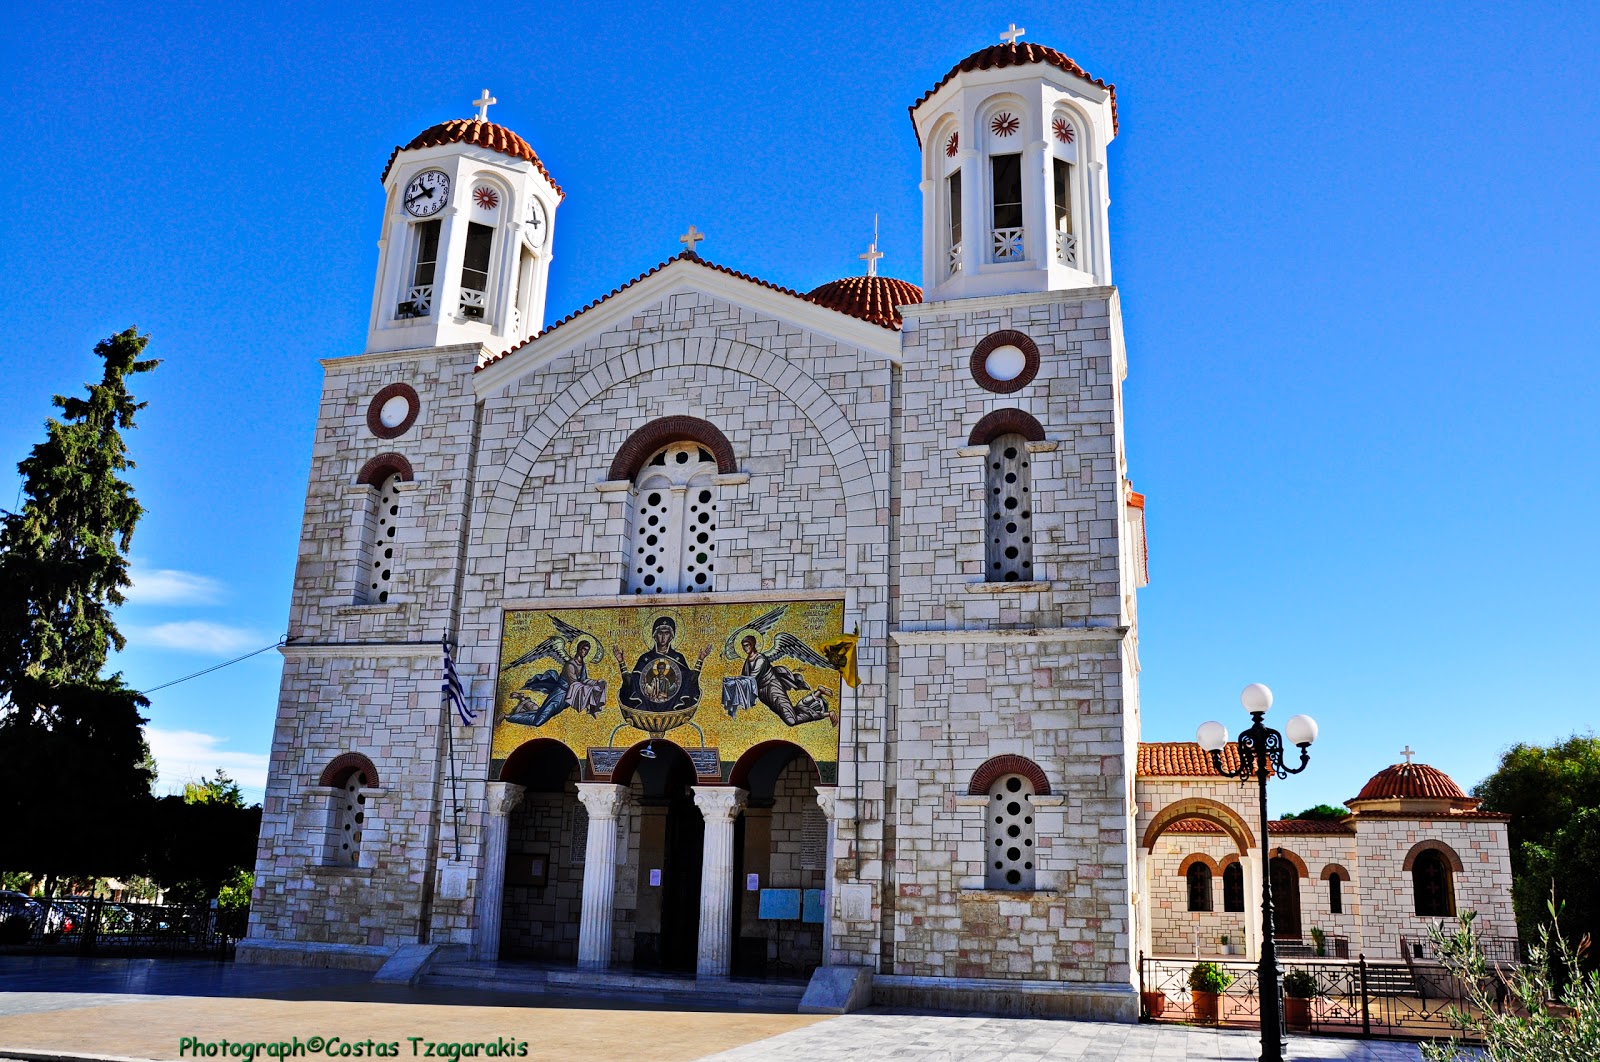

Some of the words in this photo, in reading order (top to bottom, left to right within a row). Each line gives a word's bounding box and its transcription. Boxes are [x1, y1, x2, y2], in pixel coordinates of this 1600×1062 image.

[427, 172, 434, 182] 12
[441, 179, 446, 187] 2
[411, 184, 418, 192] 10
[443, 187, 448, 195] 3
[416, 204, 421, 212] 7
[423, 205, 428, 214] 6
[432, 202, 437, 211] 5
